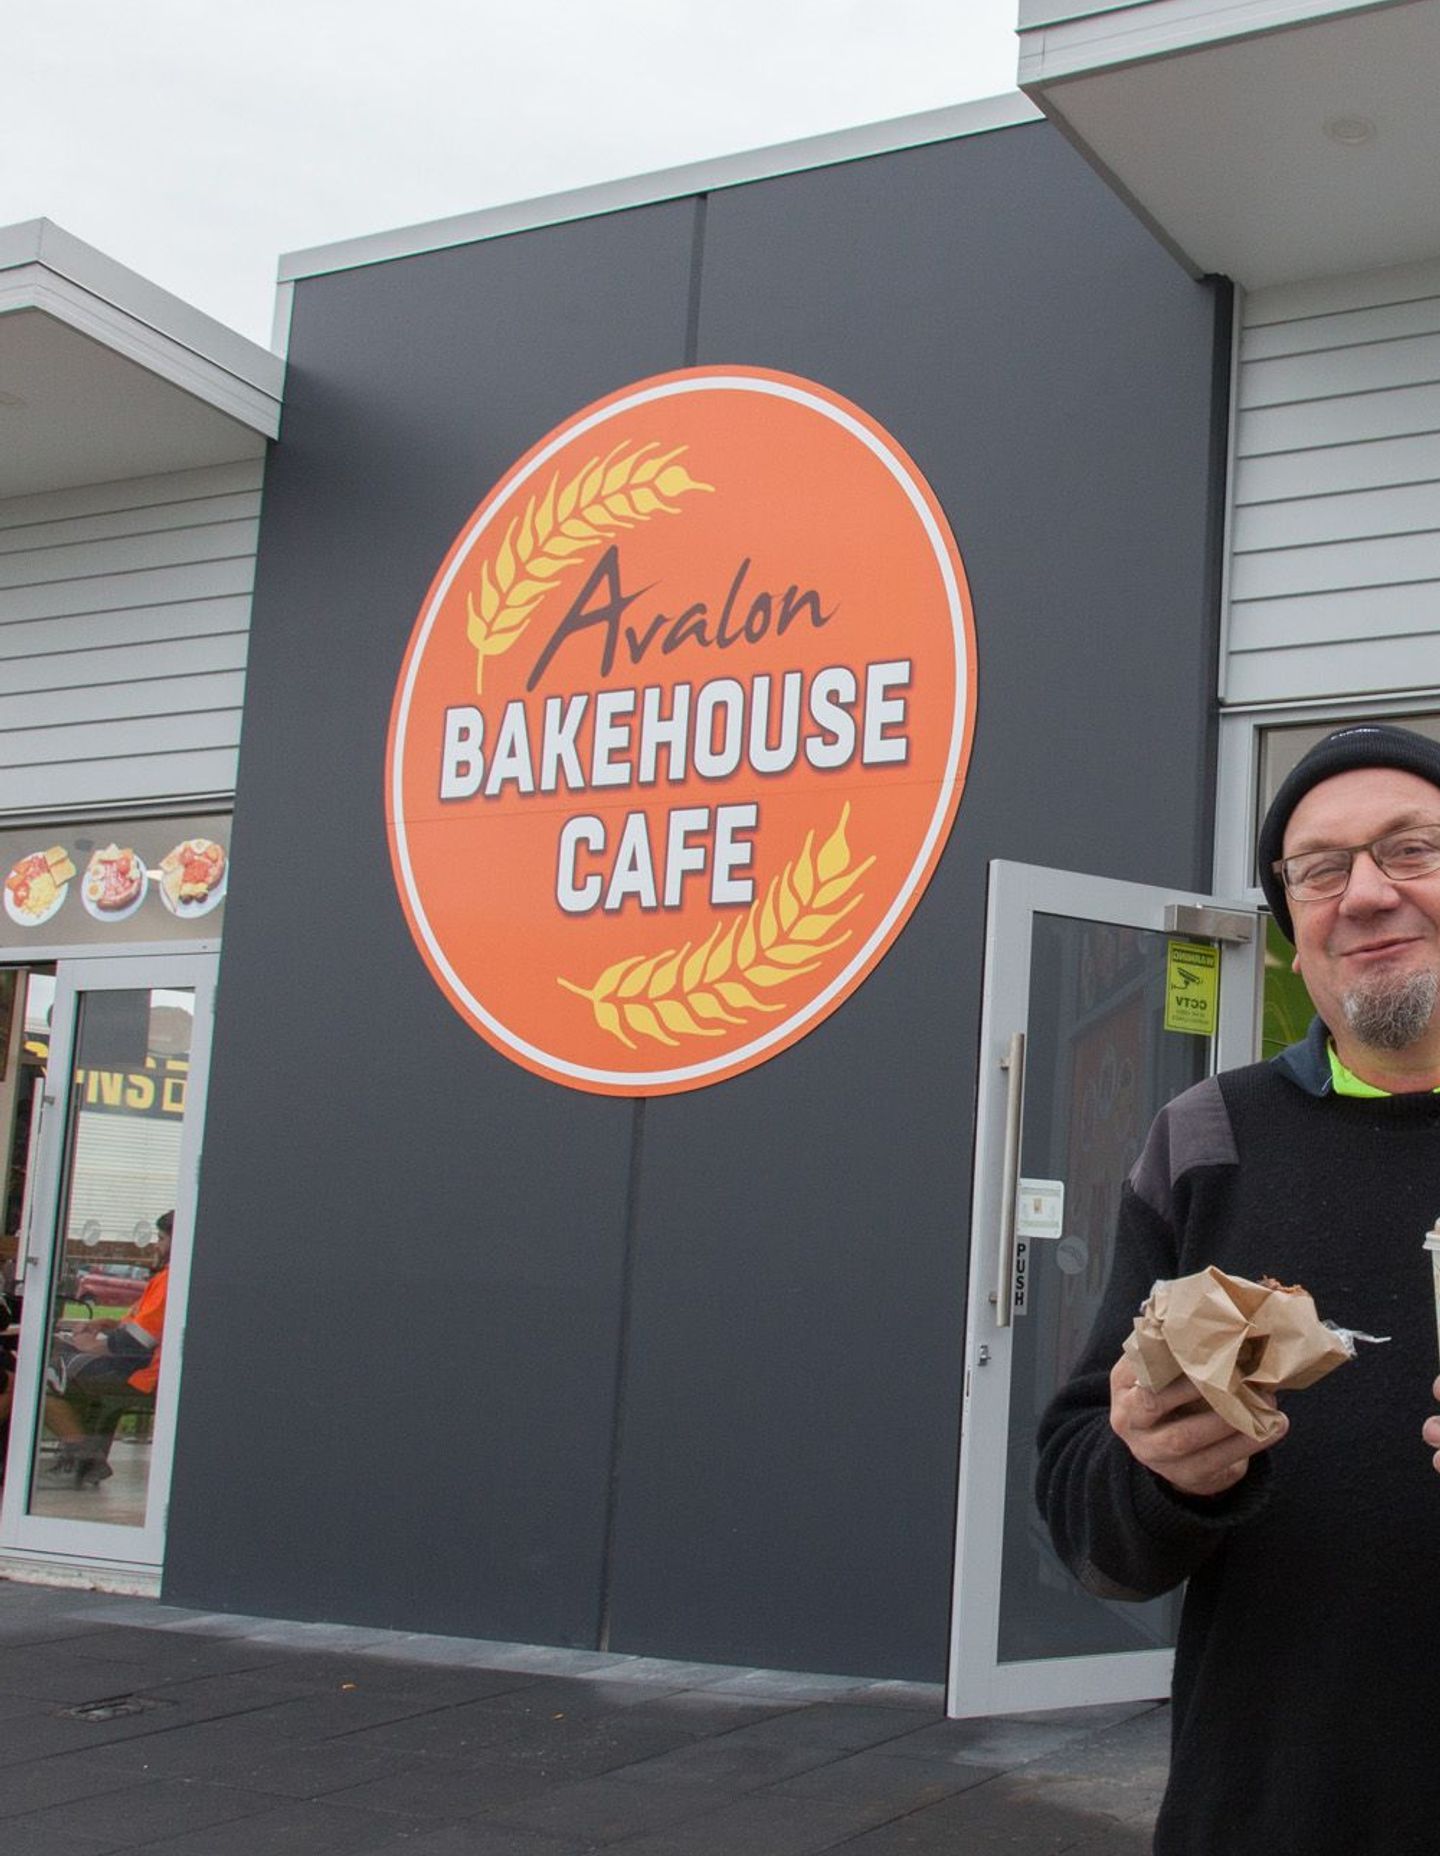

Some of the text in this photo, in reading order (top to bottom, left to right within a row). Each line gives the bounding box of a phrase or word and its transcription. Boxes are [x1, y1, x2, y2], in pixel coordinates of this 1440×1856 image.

[526, 545, 841, 692] Avalon
[439, 659, 912, 800] BAKEHOUSE
[556, 802, 759, 913] CAFE
[1015, 1243, 1026, 1306] PUSH
